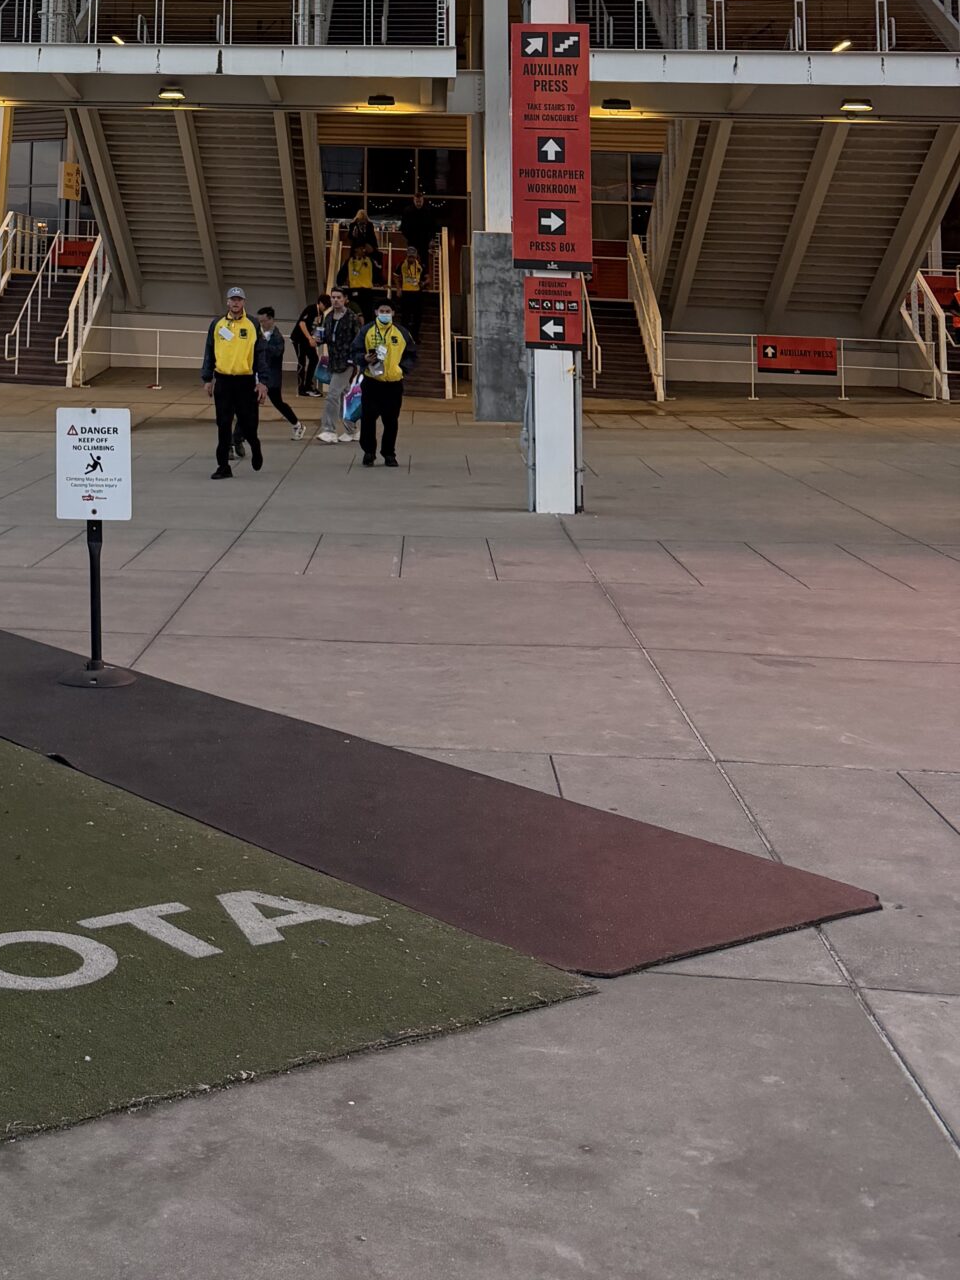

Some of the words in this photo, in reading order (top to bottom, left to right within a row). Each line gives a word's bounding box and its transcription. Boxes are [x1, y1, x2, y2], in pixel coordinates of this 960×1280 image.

[522, 63, 579, 77] AUXILIARY
[533, 80, 569, 93] PRESS
[527, 103, 542, 111] TAKE
[544, 103, 565, 111] STAIRS
[566, 103, 576, 112] TO
[541, 114, 578, 123] CONCOURSE
[519, 168, 585, 180] PHOTOGRAPHER
[527, 183, 577, 195] WORKROOM
[529, 241, 557, 252] PRESS
[559, 242, 576, 253] BOX
[538, 280, 568, 288] FREQUENCY
[534, 289, 572, 297] COORDINATION
[780, 348, 811, 357] AUXILIARY
[813, 350, 834, 359] PRESS
[80, 426, 119, 435] DANGER
